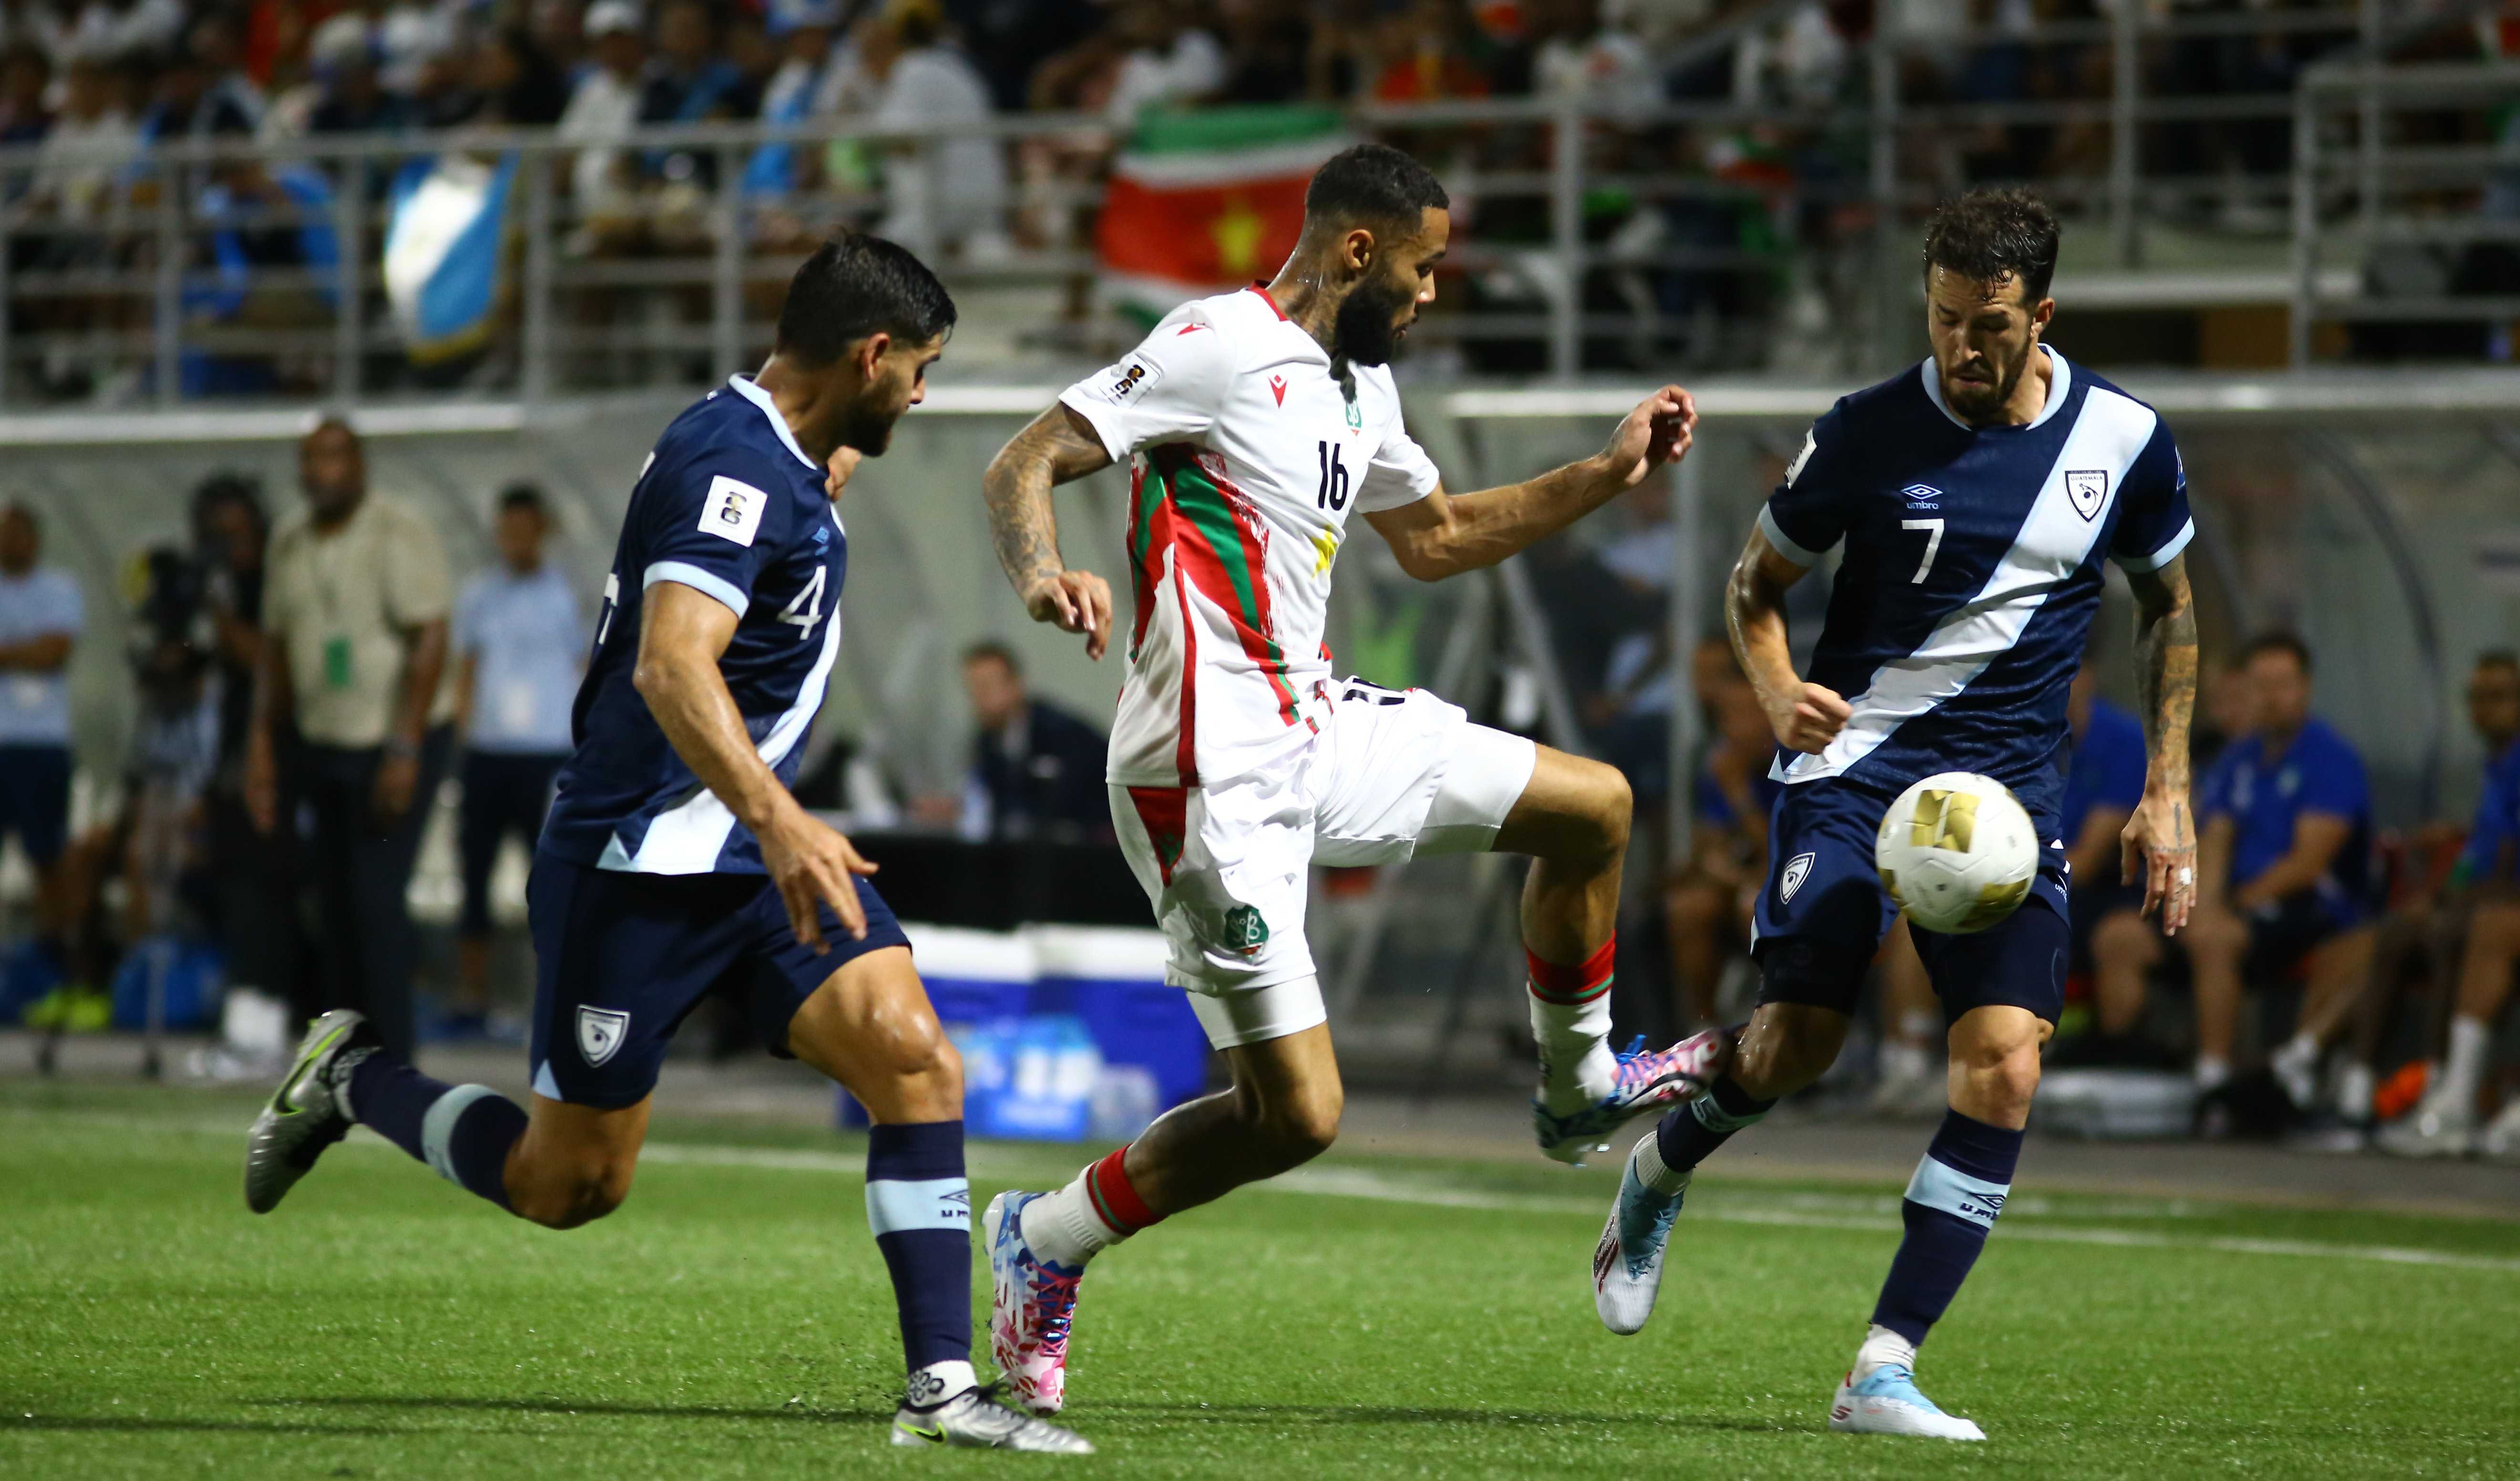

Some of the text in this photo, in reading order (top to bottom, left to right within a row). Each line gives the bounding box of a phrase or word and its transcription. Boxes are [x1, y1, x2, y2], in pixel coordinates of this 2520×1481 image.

[1318, 440, 1349, 511] 16
[1906, 501, 1939, 510] umbro
[1901, 518, 1945, 584] 7
[777, 565, 827, 640] 4
